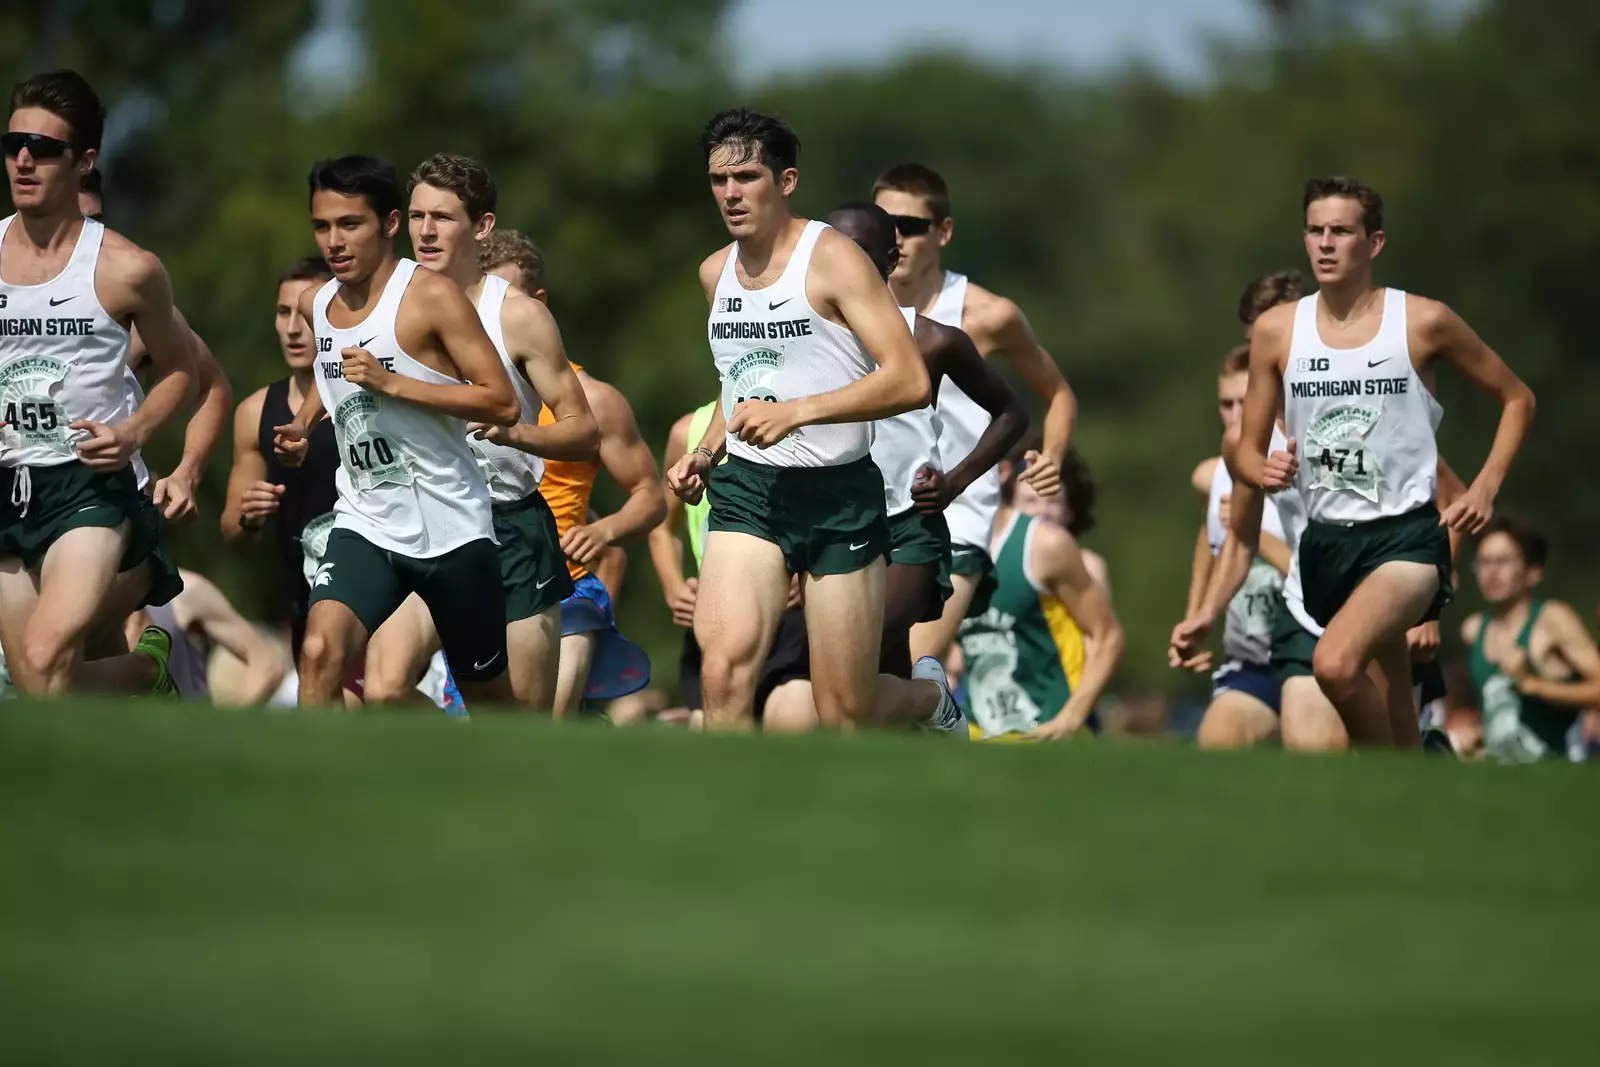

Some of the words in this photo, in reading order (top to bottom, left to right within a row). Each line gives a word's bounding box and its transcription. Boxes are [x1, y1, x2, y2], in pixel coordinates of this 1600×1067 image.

[46, 319, 95, 335] STATE
[711, 322, 766, 339] MICHIGAN
[767, 318, 813, 339] STATE
[729, 351, 780, 377] SPARTAN
[733, 359, 780, 381] INVITATIONAL
[1290, 380, 1361, 398] MICHIGAN
[1365, 378, 1409, 395] STATE
[5, 403, 57, 431] 455
[349, 437, 394, 470] 470
[1320, 449, 1367, 475] 471
